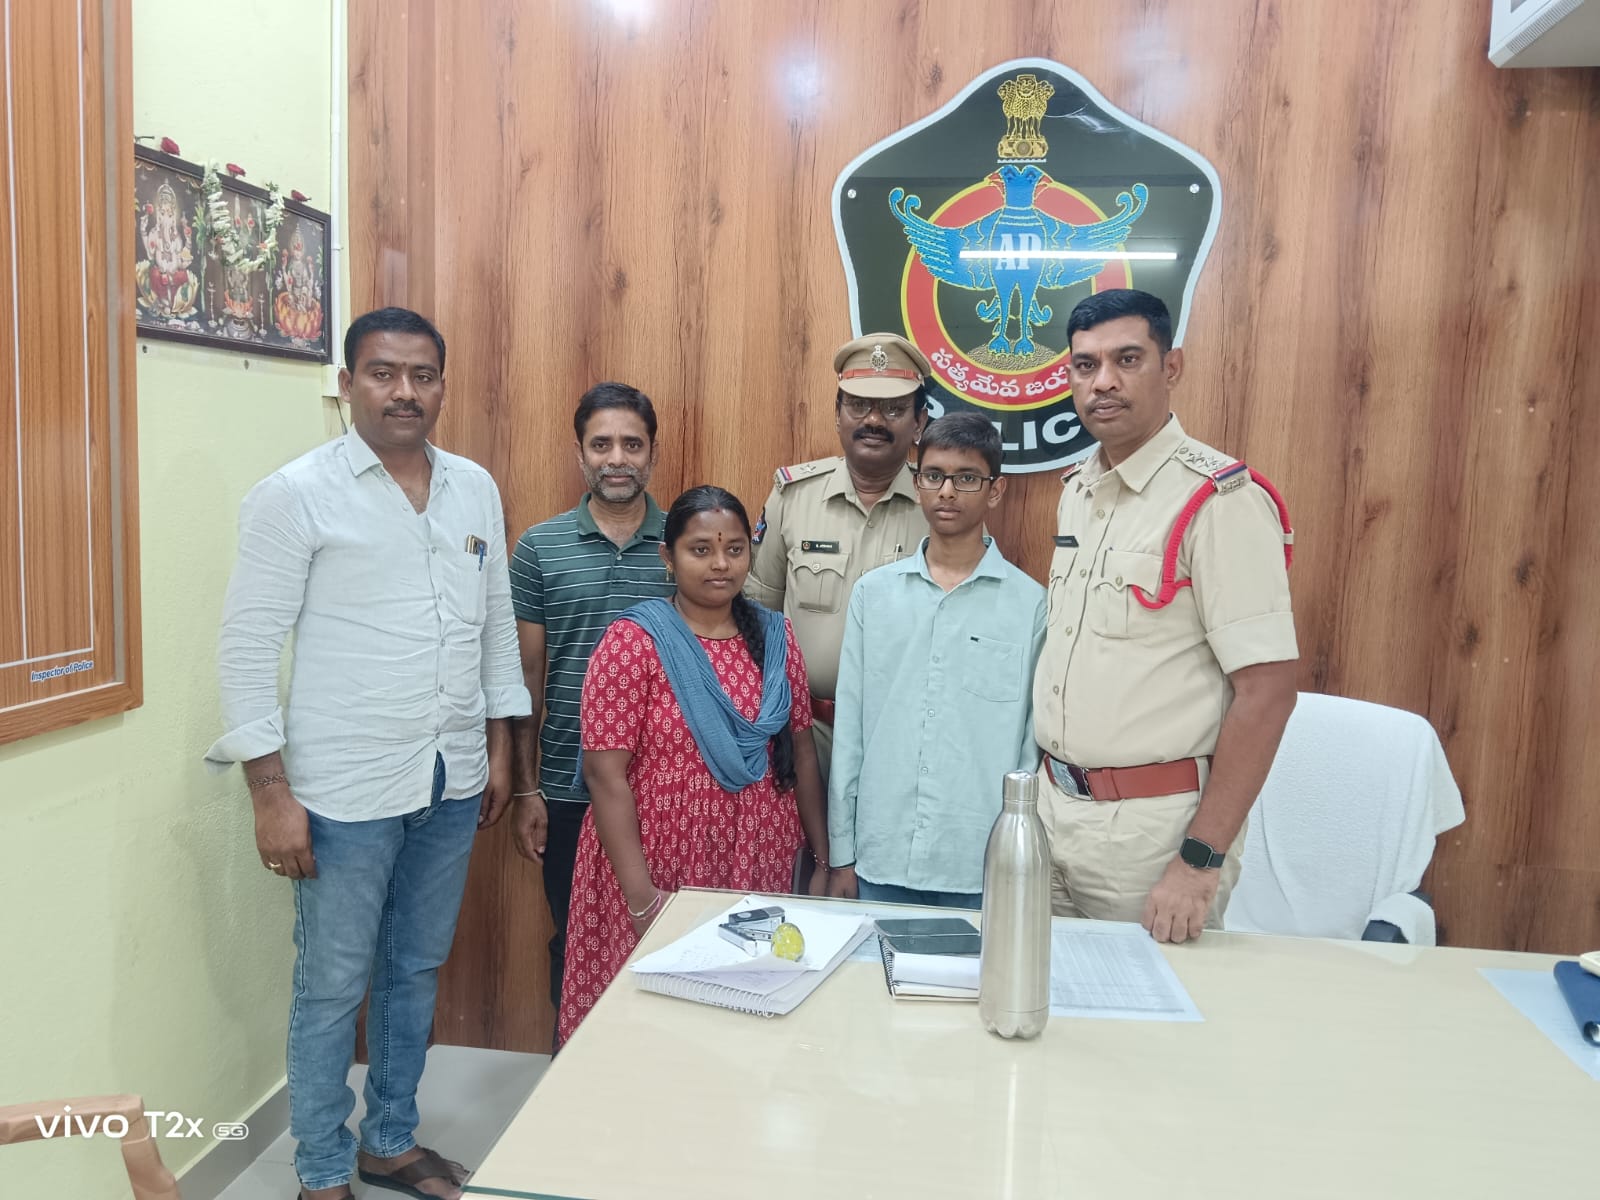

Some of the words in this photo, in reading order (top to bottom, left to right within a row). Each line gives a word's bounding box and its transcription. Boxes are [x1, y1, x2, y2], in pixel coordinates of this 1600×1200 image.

[995, 233, 1042, 270] AP
[931, 348, 1021, 398] సత్యమేవ
[1025, 366, 1068, 397] జయ
[31, 667, 64, 681] Inspector
[65, 664, 73, 674] of
[74, 660, 93, 672] Police
